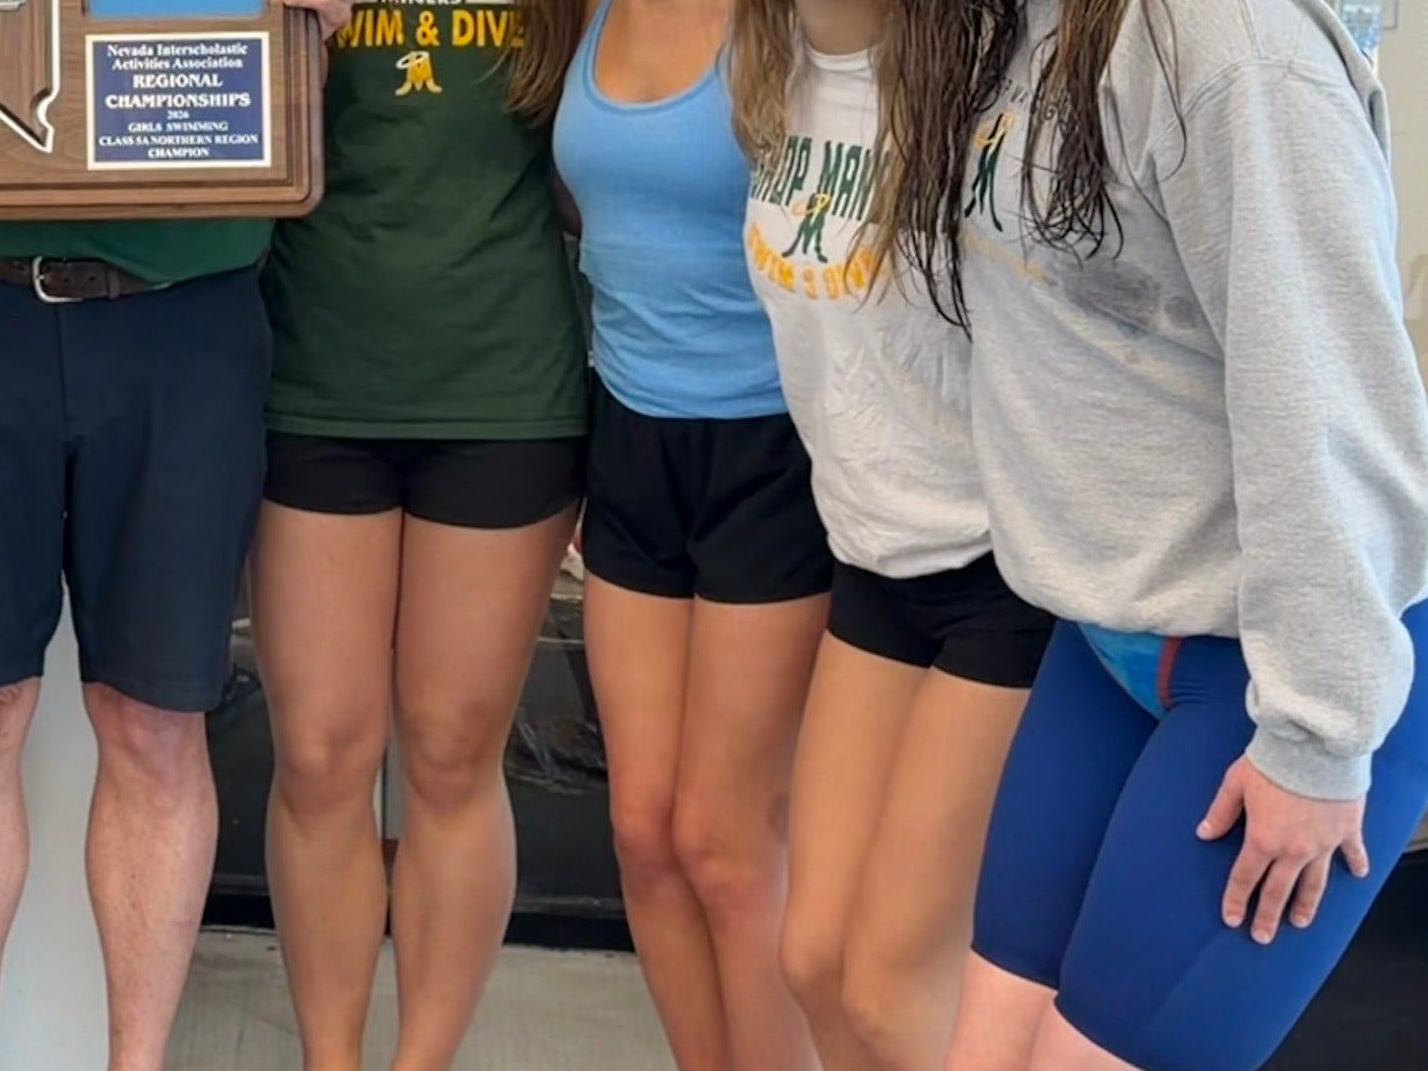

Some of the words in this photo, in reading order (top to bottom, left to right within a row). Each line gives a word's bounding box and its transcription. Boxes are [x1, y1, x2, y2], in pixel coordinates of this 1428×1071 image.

[336, 8, 404, 48] WIM
[415, 10, 441, 47] &
[107, 44, 154, 57] Nevada
[157, 42, 248, 56] Interscholastic
[112, 58, 170, 70] Activities
[172, 56, 243, 70] Association
[132, 73, 223, 88] REGIONAL
[105, 92, 251, 109] CHAMPIONSHIPS
[128, 122, 162, 133] GIRLS
[166, 121, 229, 132] SWIMMING
[98, 135, 136, 147] CLASS
[149, 133, 212, 145] NORTHERN
[214, 132, 260, 144] REGION
[147, 146, 210, 159] CHAMPION
